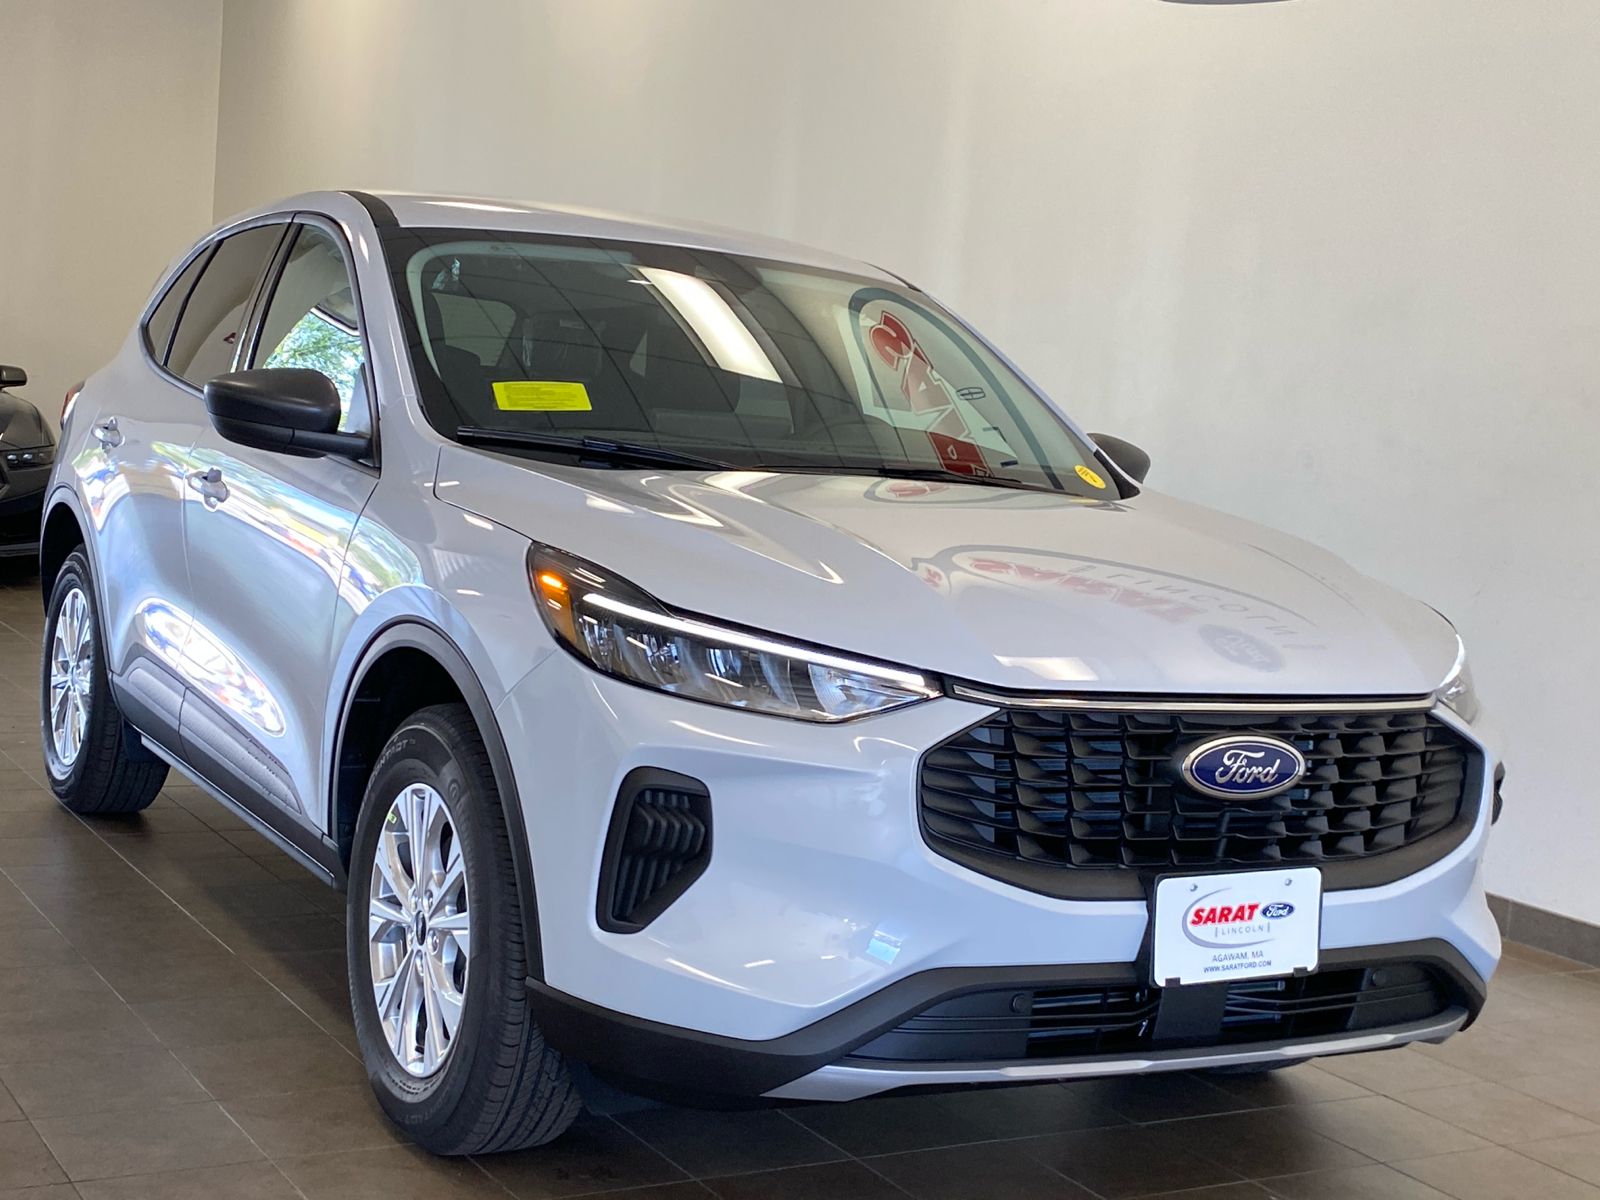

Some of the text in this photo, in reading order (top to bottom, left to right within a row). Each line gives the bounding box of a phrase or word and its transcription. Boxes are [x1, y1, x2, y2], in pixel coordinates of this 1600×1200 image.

[1215, 749, 1281, 784] Ford
[1190, 902, 1290, 926] SARAT Ford
[1221, 924, 1264, 935] LINCOLN
[1212, 950, 1264, 963] AGAWAM, MA
[1203, 960, 1272, 973] WWW.SARATFORD.COM
